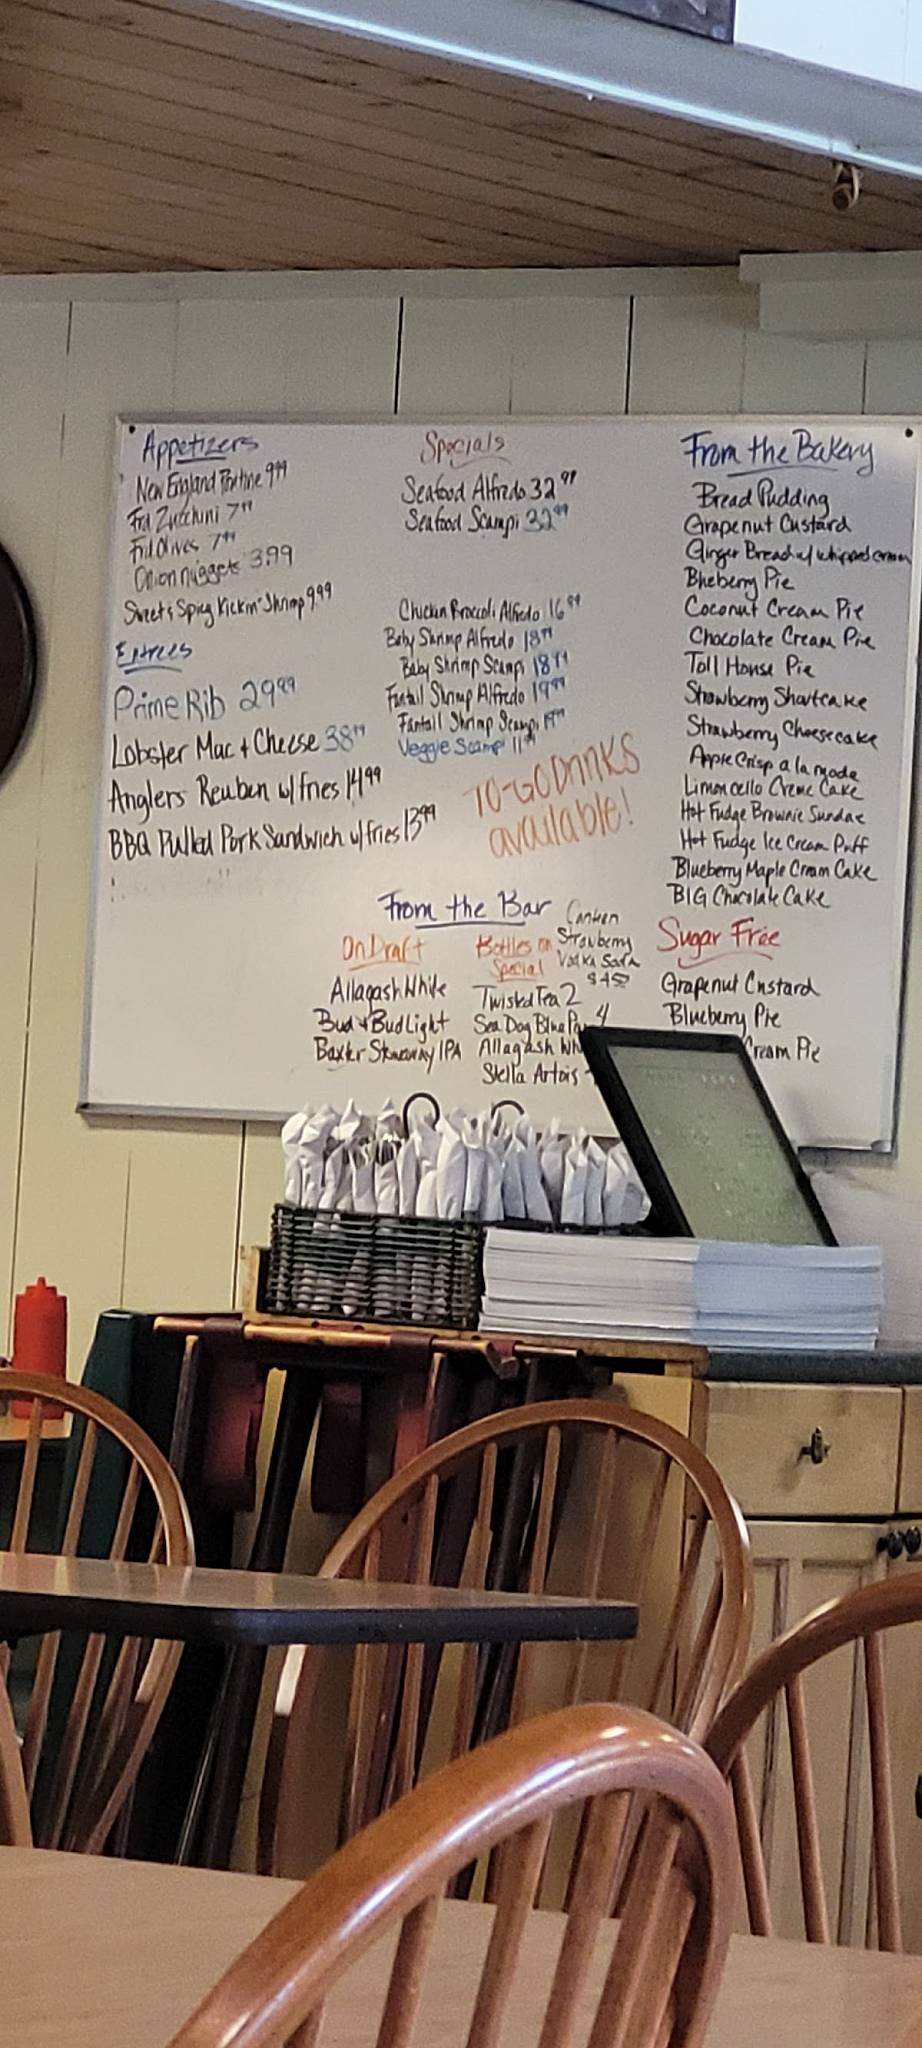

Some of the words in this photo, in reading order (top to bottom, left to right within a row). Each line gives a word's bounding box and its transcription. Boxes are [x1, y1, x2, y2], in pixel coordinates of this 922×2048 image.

[142, 429, 258, 470] Appetizers
[420, 430, 505, 465] Specials
[680, 431, 741, 468] From
[748, 434, 789, 464] the
[792, 428, 874, 478] Bakery
[136, 476, 162, 504] New
[168, 469, 216, 511] England
[219, 467, 263, 495] Poutine
[401, 474, 465, 504] Seafood
[472, 472, 526, 501] Alfredo
[692, 481, 752, 508] Bread
[757, 478, 830, 519] Pudding
[156, 505, 219, 533] Zucchini
[405, 506, 462, 532] Seafood
[468, 505, 519, 538] Scampi
[683, 513, 773, 539] Grapenut
[780, 513, 852, 534] Custard
[157, 535, 200, 557] Olives
[685, 538, 739, 568] Ginger
[744, 540, 794, 561] Bread
[134, 566, 176, 592] Onion
[250, 545, 292, 568] 3.99
[684, 567, 759, 601] Blueberry
[765, 566, 795, 590] Pie
[124, 600, 166, 625] Sweet
[177, 598, 215, 628] Spicy
[264, 592, 304, 619] Shrimp
[400, 598, 447, 622] Chicken
[451, 598, 496, 621] Broccoli
[500, 600, 540, 622] Alfredo
[685, 595, 758, 617] Coconut
[766, 598, 829, 619] Cream
[836, 598, 864, 620] Pie
[385, 627, 415, 656] Baby
[419, 627, 462, 652] Shrimp
[467, 626, 514, 650] Alfredo
[689, 626, 773, 647] Chocolate
[782, 625, 836, 649] Cream
[843, 627, 875, 650] Pie
[116, 642, 192, 667] Entrees
[401, 656, 429, 683] Baby
[434, 655, 479, 679] Shrimp
[484, 654, 525, 682] Scampi
[684, 651, 718, 676] Toll
[726, 656, 773, 676] House
[786, 654, 816, 678] Pie
[114, 685, 180, 721] Prime
[187, 685, 226, 722] Rib
[385, 683, 424, 712] Fantail
[430, 680, 473, 712] Shrimp
[478, 682, 525, 707] Alfredo
[684, 681, 769, 715] Strawberry
[774, 687, 867, 711] Shortcake
[398, 712, 442, 734] Fantail
[450, 711, 494, 737] Shrimp
[500, 710, 540, 738] Scampi
[687, 714, 779, 750] Strawberry
[783, 718, 878, 749] Cheesecake
[112, 734, 188, 770] Lobster
[196, 730, 235, 760] Mac
[254, 728, 320, 756] Cheese
[398, 738, 450, 764] Veggie
[454, 738, 505, 757] Scampi
[690, 745, 733, 769] Apple
[735, 751, 773, 776] Crisp
[779, 760, 790, 771] a
[795, 756, 809, 774] la
[814, 764, 859, 784] mode
[109, 778, 186, 825] Anglers
[197, 774, 268, 807] Reuben
[769, 775, 814, 797] Creme
[819, 780, 864, 800] Cake
[681, 799, 705, 822] Hot
[709, 801, 746, 832] Fudge
[750, 801, 804, 823] Brownie
[808, 805, 866, 825] Sundae
[108, 830, 151, 860] BBQ
[158, 827, 213, 858] Pulled
[220, 823, 259, 853] Pork
[263, 823, 345, 849] Sandwich
[680, 828, 707, 850] Hot
[713, 830, 756, 860] Fudge
[763, 831, 782, 850] Ice
[787, 834, 829, 851] Cream
[834, 833, 869, 854] Puff
[672, 856, 742, 888] Blueberry
[745, 858, 786, 887] Maple
[789, 858, 830, 878] Cream
[834, 858, 878, 881] Cake
[377, 889, 437, 921] From
[446, 894, 486, 920] the
[497, 889, 552, 918] Bar
[667, 883, 707, 907] BIG
[712, 884, 780, 907] Chocolate
[783, 885, 831, 908] Cake
[341, 935, 366, 961] On
[370, 935, 426, 962] Draft
[476, 934, 532, 958] Bottles
[557, 927, 633, 953] Strawberry
[657, 916, 721, 960] Sugar
[731, 917, 781, 947] Free
[492, 959, 544, 983] Special
[557, 949, 597, 968] Vodka
[601, 953, 640, 968] Soda
[330, 976, 401, 1010] Allagash
[405, 974, 447, 999] White
[472, 985, 534, 1011] Twisted
[536, 985, 561, 1008] Tea
[560, 982, 582, 1007] 2
[661, 972, 738, 1001] Grapenut
[745, 970, 820, 997] Custard
[313, 1008, 354, 1033] Bud
[371, 1008, 403, 1033] Bud
[407, 1010, 450, 1044] Light
[473, 1014, 501, 1035] Sea
[503, 1014, 532, 1040] Dog
[533, 1012, 565, 1034] Blue
[596, 1002, 609, 1027] 4
[663, 1002, 746, 1040] Blueberry
[754, 1002, 781, 1028] Pie
[313, 1036, 366, 1062] Baxter
[439, 1039, 462, 1061] IPA
[479, 1037, 554, 1067] Allagash
[797, 1036, 820, 1063] Pie
[482, 1062, 525, 1085] Stella
[534, 1061, 578, 1086] Artois
